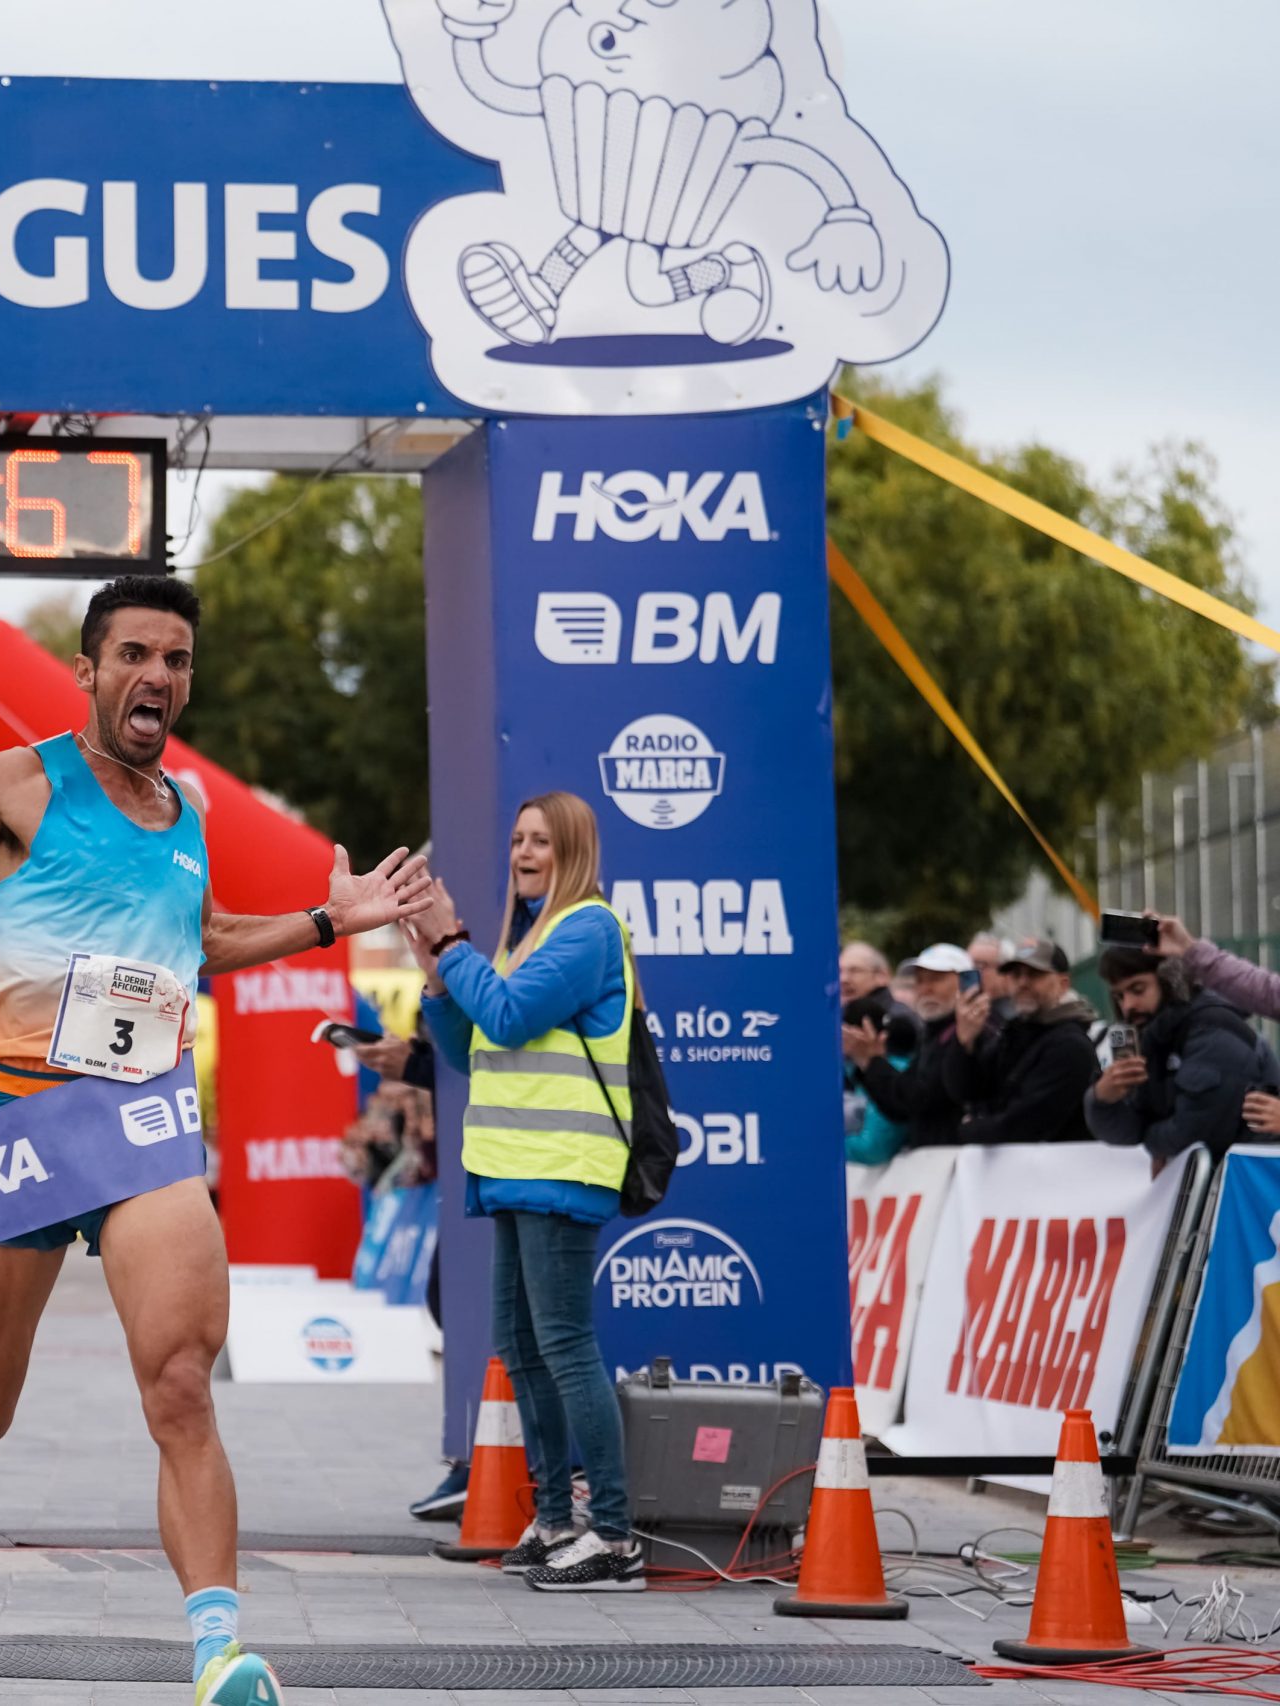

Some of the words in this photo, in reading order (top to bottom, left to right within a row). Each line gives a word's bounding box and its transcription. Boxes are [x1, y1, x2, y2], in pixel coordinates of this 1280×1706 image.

[532, 470, 772, 542] HOKA
[631, 592, 782, 665] BM
[625, 733, 698, 753] RADIO
[615, 759, 712, 790] MARCA
[173, 850, 201, 878] HOKA
[600, 879, 793, 956] ARCA
[111, 980, 153, 997] AFICIONES
[109, 1018, 135, 1056] 3
[676, 1005, 731, 1039] RÍO
[671, 1047, 683, 1062] &
[688, 1046, 772, 1062] SHOPPING
[175, 1087, 201, 1134] B
[667, 1111, 759, 1168] OBI
[657, 1234, 690, 1245] Pascual
[610, 1248, 742, 1283] DINAMIC
[612, 1281, 740, 1308] PROTEIN
[946, 1218, 1126, 1412] MARCA
